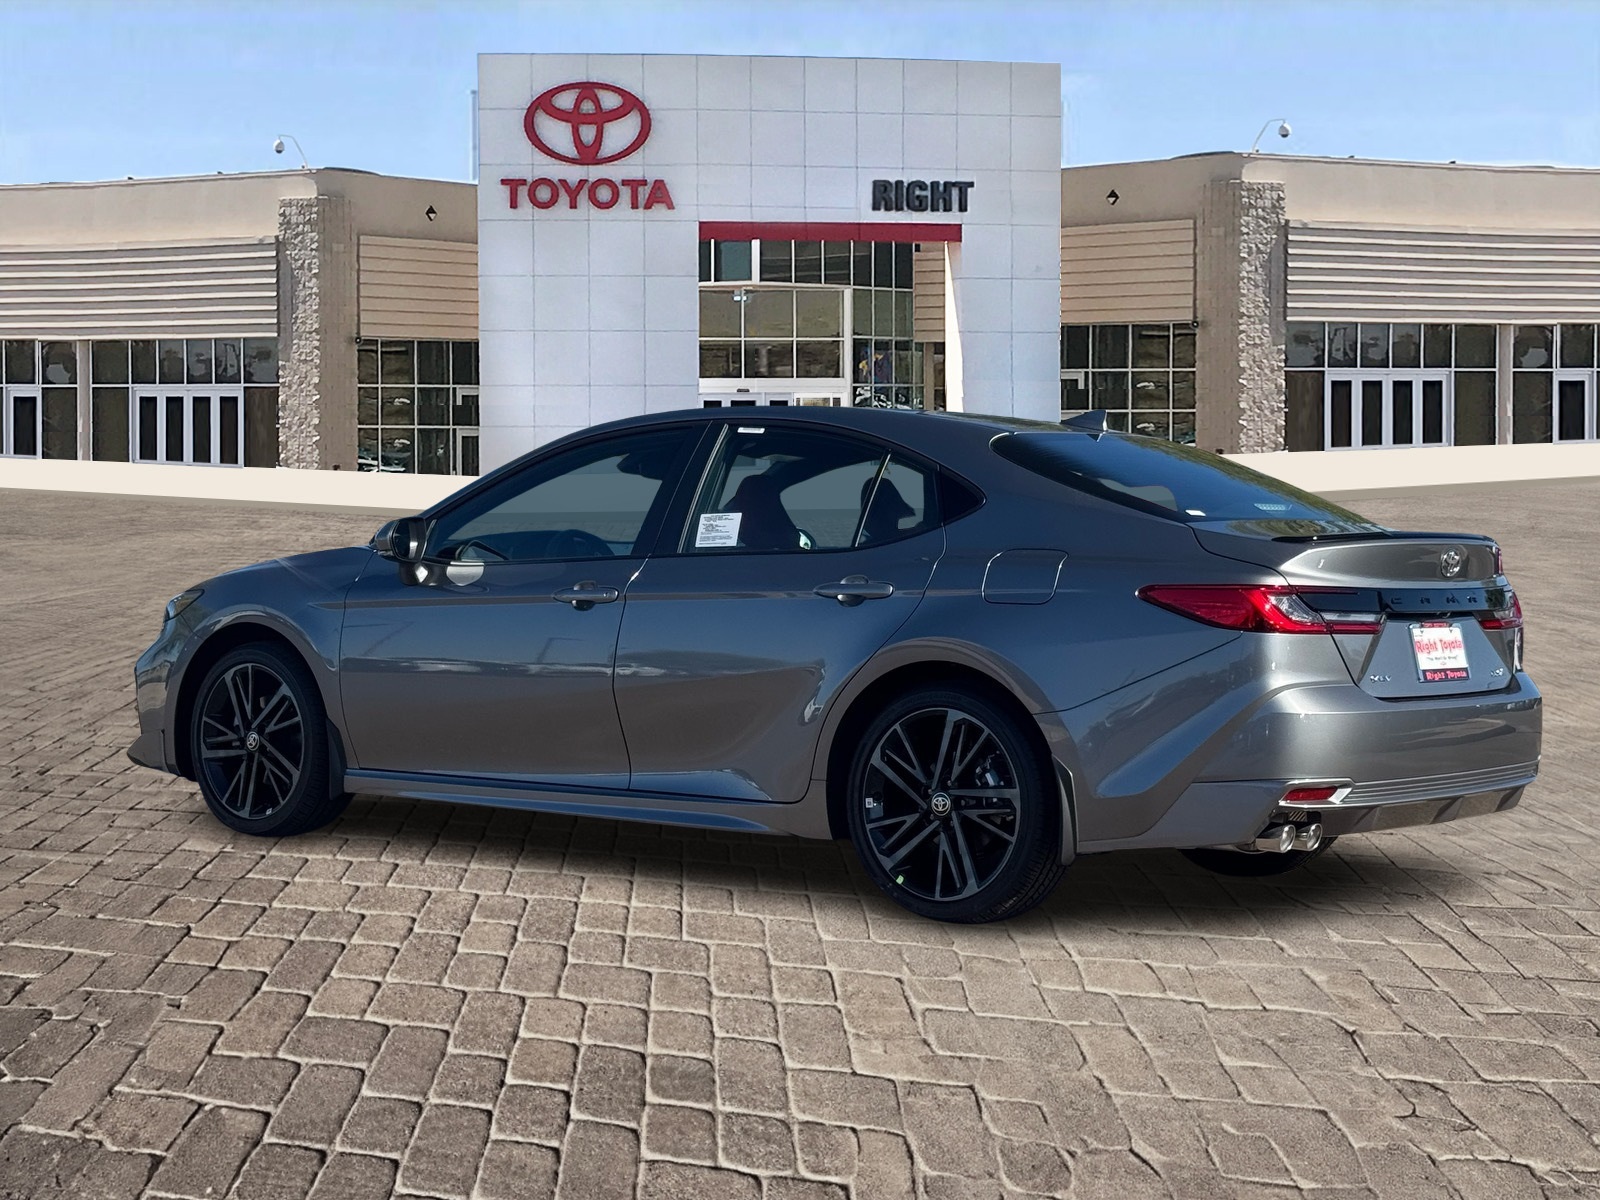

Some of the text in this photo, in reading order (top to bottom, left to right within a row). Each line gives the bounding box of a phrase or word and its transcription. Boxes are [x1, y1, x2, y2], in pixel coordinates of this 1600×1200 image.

[500, 177, 675, 210] TOYOTA
[872, 179, 975, 212] RIGHT
[1415, 638, 1463, 654] Right Toyota
[1426, 670, 1467, 680] Right Toyota
